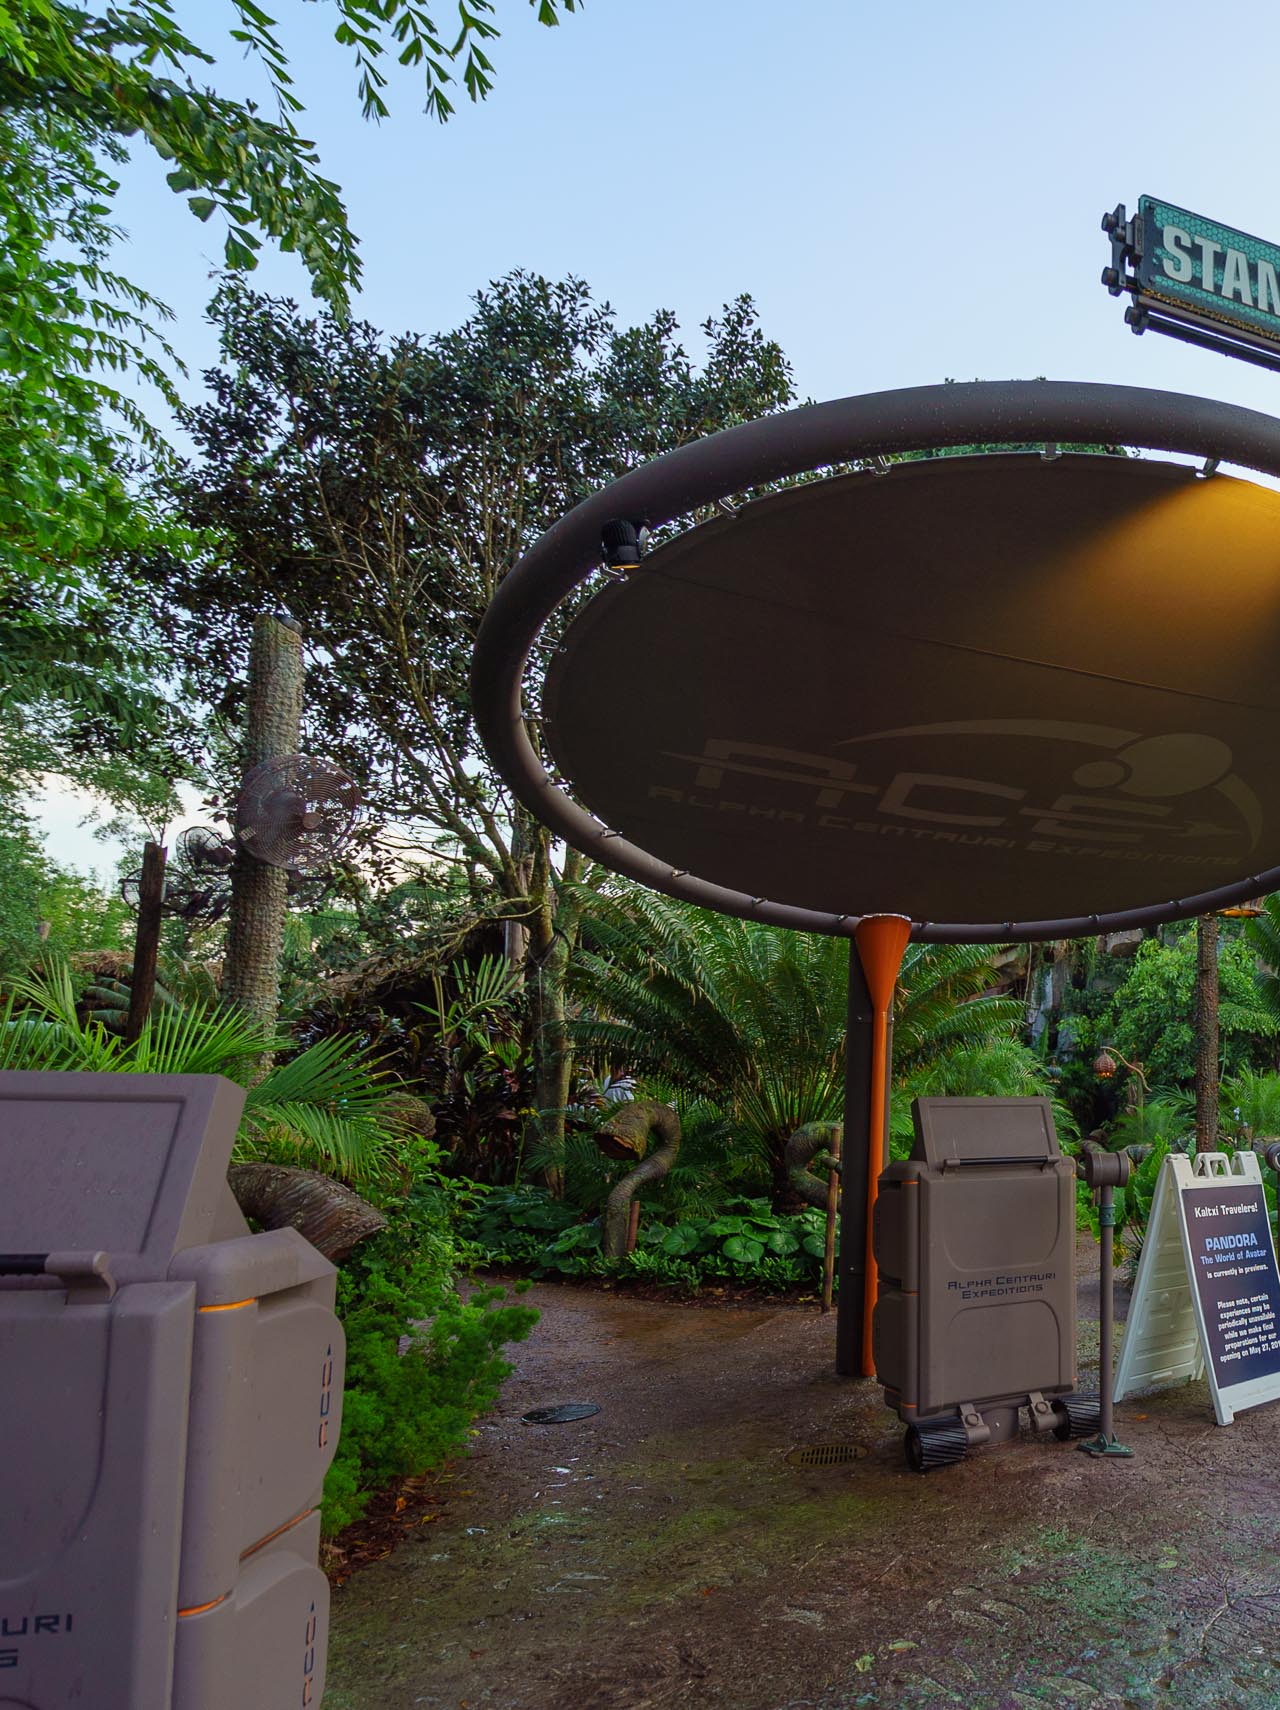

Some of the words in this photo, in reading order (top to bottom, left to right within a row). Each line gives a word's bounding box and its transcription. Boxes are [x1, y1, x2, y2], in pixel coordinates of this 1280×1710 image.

[647, 784, 804, 825] ALPHA
[817, 813, 1015, 850] CENTAURI
[1024, 839, 1240, 867] EXPEDITIONS
[1194, 1205, 1219, 1218] Kaltxi
[1220, 1202, 1258, 1216] Travelers!
[1205, 1232, 1258, 1251] PANDORA
[1200, 1255, 1214, 1265] The
[1215, 1252, 1235, 1263] World
[1236, 1250, 1244, 1260] of
[1245, 1249, 1267, 1259] Avatar
[1206, 1271, 1213, 1279] is
[1213, 1267, 1238, 1278] currently
[1238, 1266, 1244, 1274] in
[1244, 1263, 1269, 1274] previews.
[947, 1279, 992, 1290] ALPHA
[996, 1272, 1056, 1286] CENTAURI
[962, 1284, 1043, 1299] EXPEDITIONS
[1217, 1300, 1235, 1309] Please
[1236, 1298, 1250, 1306] note,
[1250, 1293, 1269, 1303] certain
[1220, 1308, 1251, 1319] experiences
[1251, 1305, 1263, 1313] may
[1217, 1317, 1248, 1332] periodically
[1248, 1312, 1276, 1324] unavailable
[1224, 1330, 1238, 1340] while
[1239, 1329, 1248, 1337] we
[1248, 1325, 1262, 1334] make
[1262, 1322, 1274, 1331] final
[1224, 1337, 1258, 1352] preparations
[1259, 1334, 1267, 1342] for
[1268, 1332, 1277, 1340] our
[1220, 1351, 1241, 1363] opening
[1249, 1346, 1261, 1355] May
[1261, 1342, 1271, 1352] 27,
